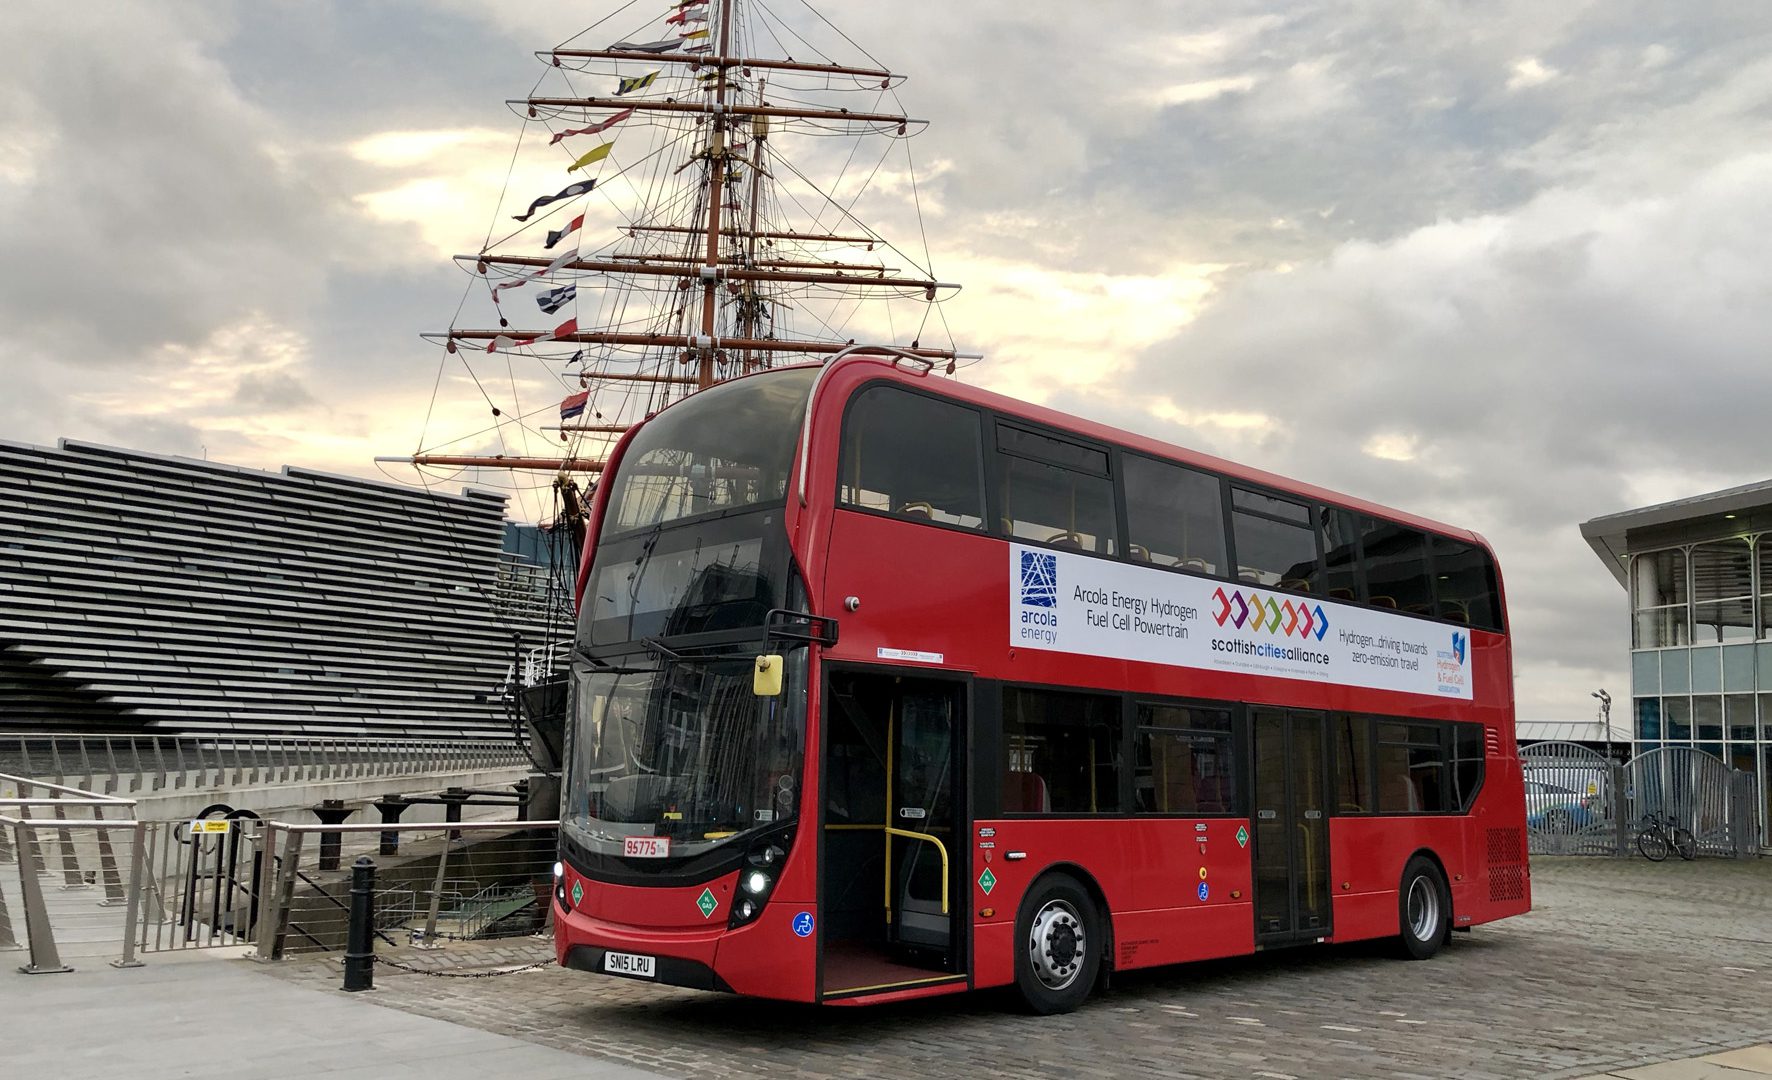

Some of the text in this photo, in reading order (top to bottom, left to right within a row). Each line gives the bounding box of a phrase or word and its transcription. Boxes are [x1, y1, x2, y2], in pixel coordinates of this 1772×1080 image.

[1074, 585, 1198, 621] Arcola Energy Hydrogen
[1021, 611, 1057, 627] arcola
[1087, 609, 1189, 639] Fuel Cell Powertrain
[1021, 627, 1057, 644] energy
[1211, 638, 1330, 665] scottishcitiesalliance
[1402, 641, 1428, 655] towards
[1352, 651, 1419, 671] zero-emission travel
[626, 840, 657, 856] 95775
[610, 954, 650, 973] SN15 LRU
